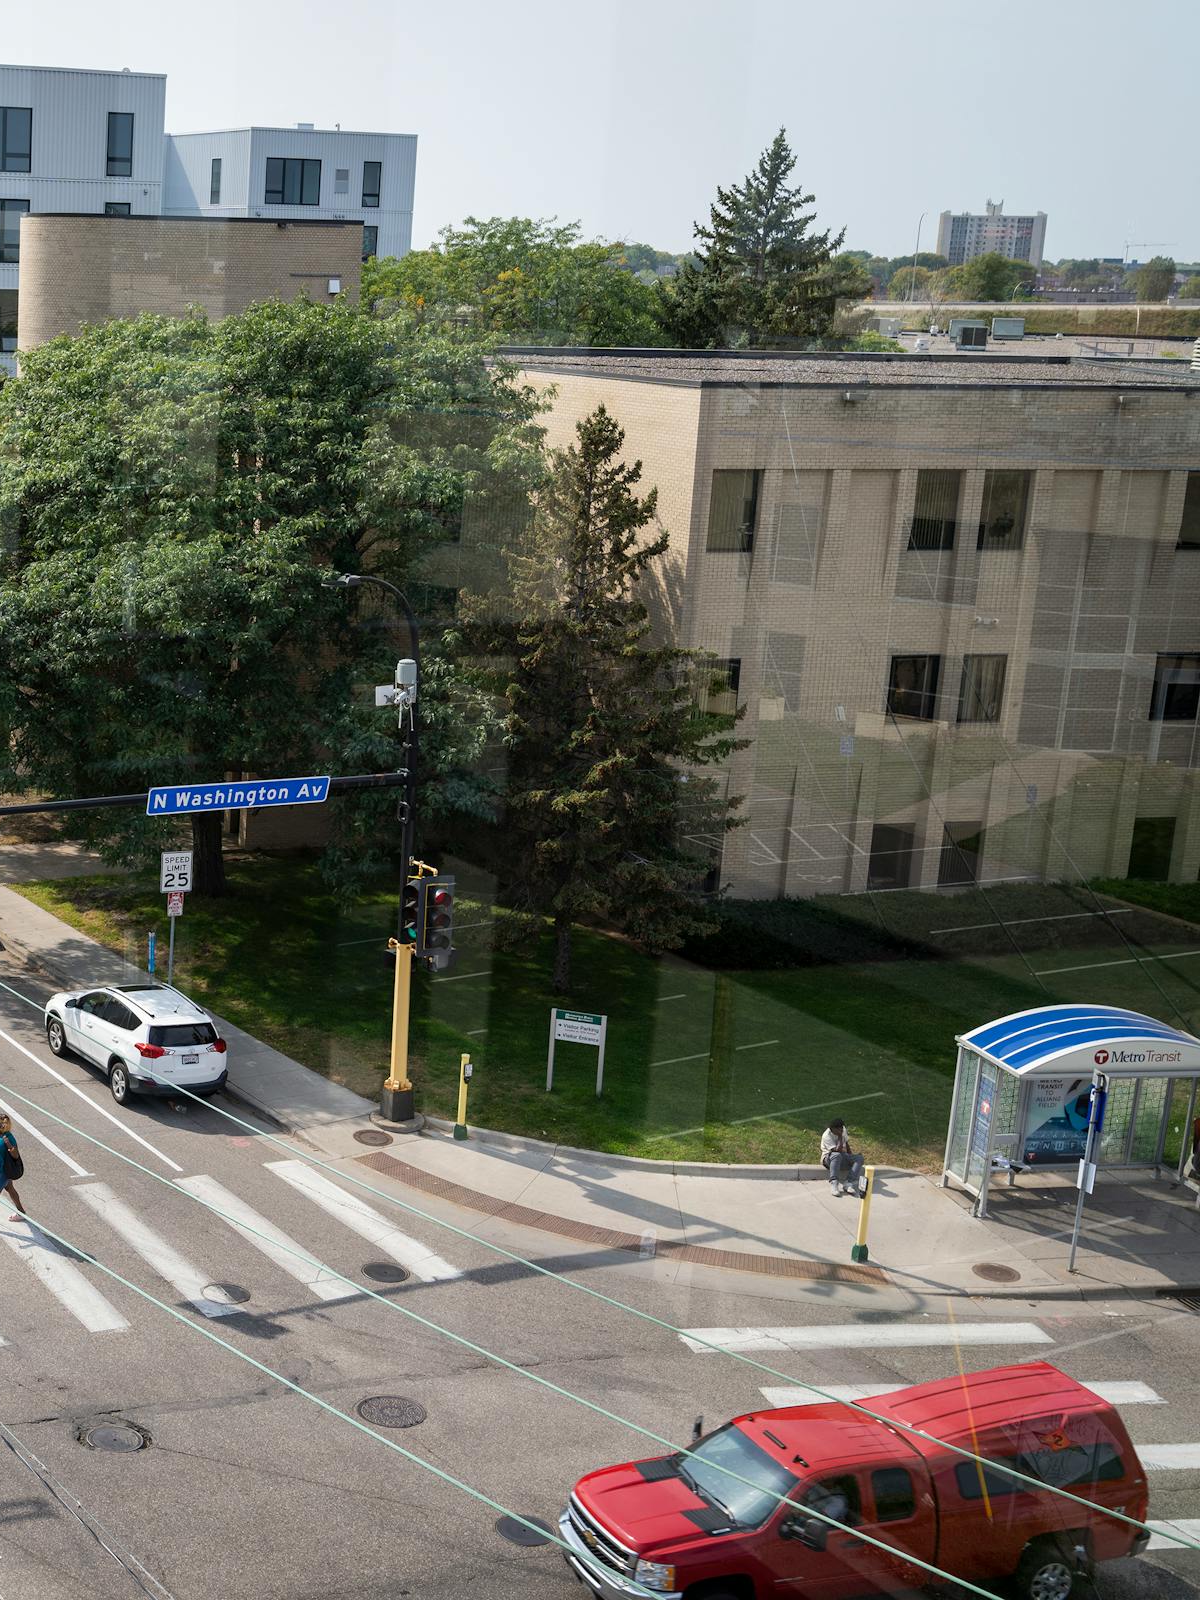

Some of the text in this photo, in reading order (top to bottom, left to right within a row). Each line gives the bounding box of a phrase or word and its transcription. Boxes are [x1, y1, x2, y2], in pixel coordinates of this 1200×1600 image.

[153, 783, 323, 809] N Washington Av
[164, 856, 190, 864] SPEED
[166, 864, 187, 872] LIMIT
[164, 872, 189, 888] 25
[1111, 1050, 1145, 1063] Metro
[1146, 1050, 1181, 1062] Transit
